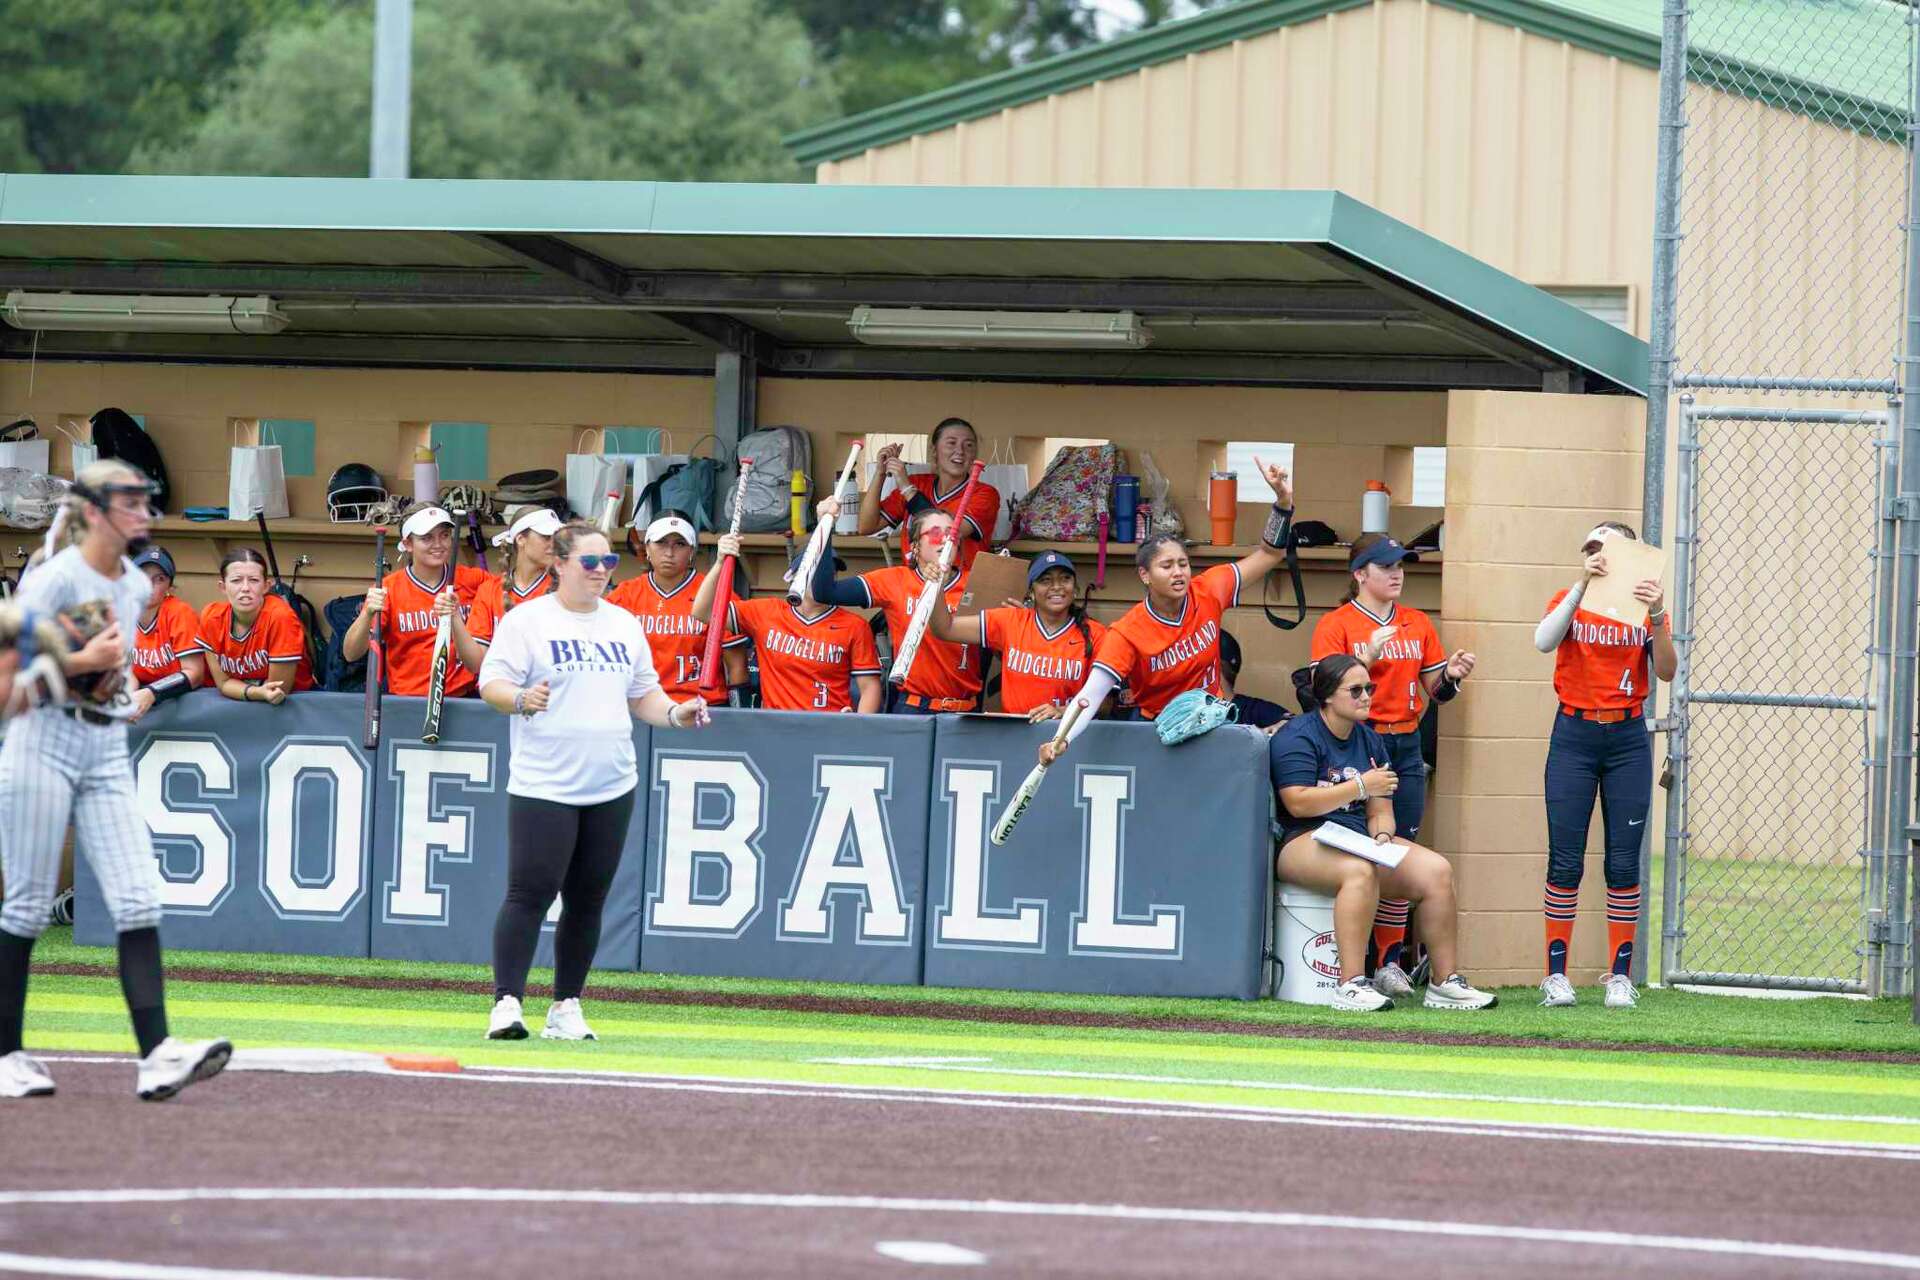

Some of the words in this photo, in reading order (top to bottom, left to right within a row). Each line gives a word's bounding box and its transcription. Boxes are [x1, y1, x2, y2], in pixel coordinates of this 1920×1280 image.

[638, 614, 704, 634] IDGELAND
[1573, 619, 1647, 647] BRIDGELAND
[548, 639, 631, 666] BEAR
[766, 629, 844, 663] BRIDGELAND
[1151, 620, 1217, 672] BRIDGELAND
[1008, 647, 1082, 680] BRIDGELAND
[431, 657, 447, 733] GHOST
[813, 681, 829, 708] 3
[1619, 668, 1634, 696] 4
[1000, 795, 1032, 841] EASTON
[134, 731, 1185, 960] SOFBALL
